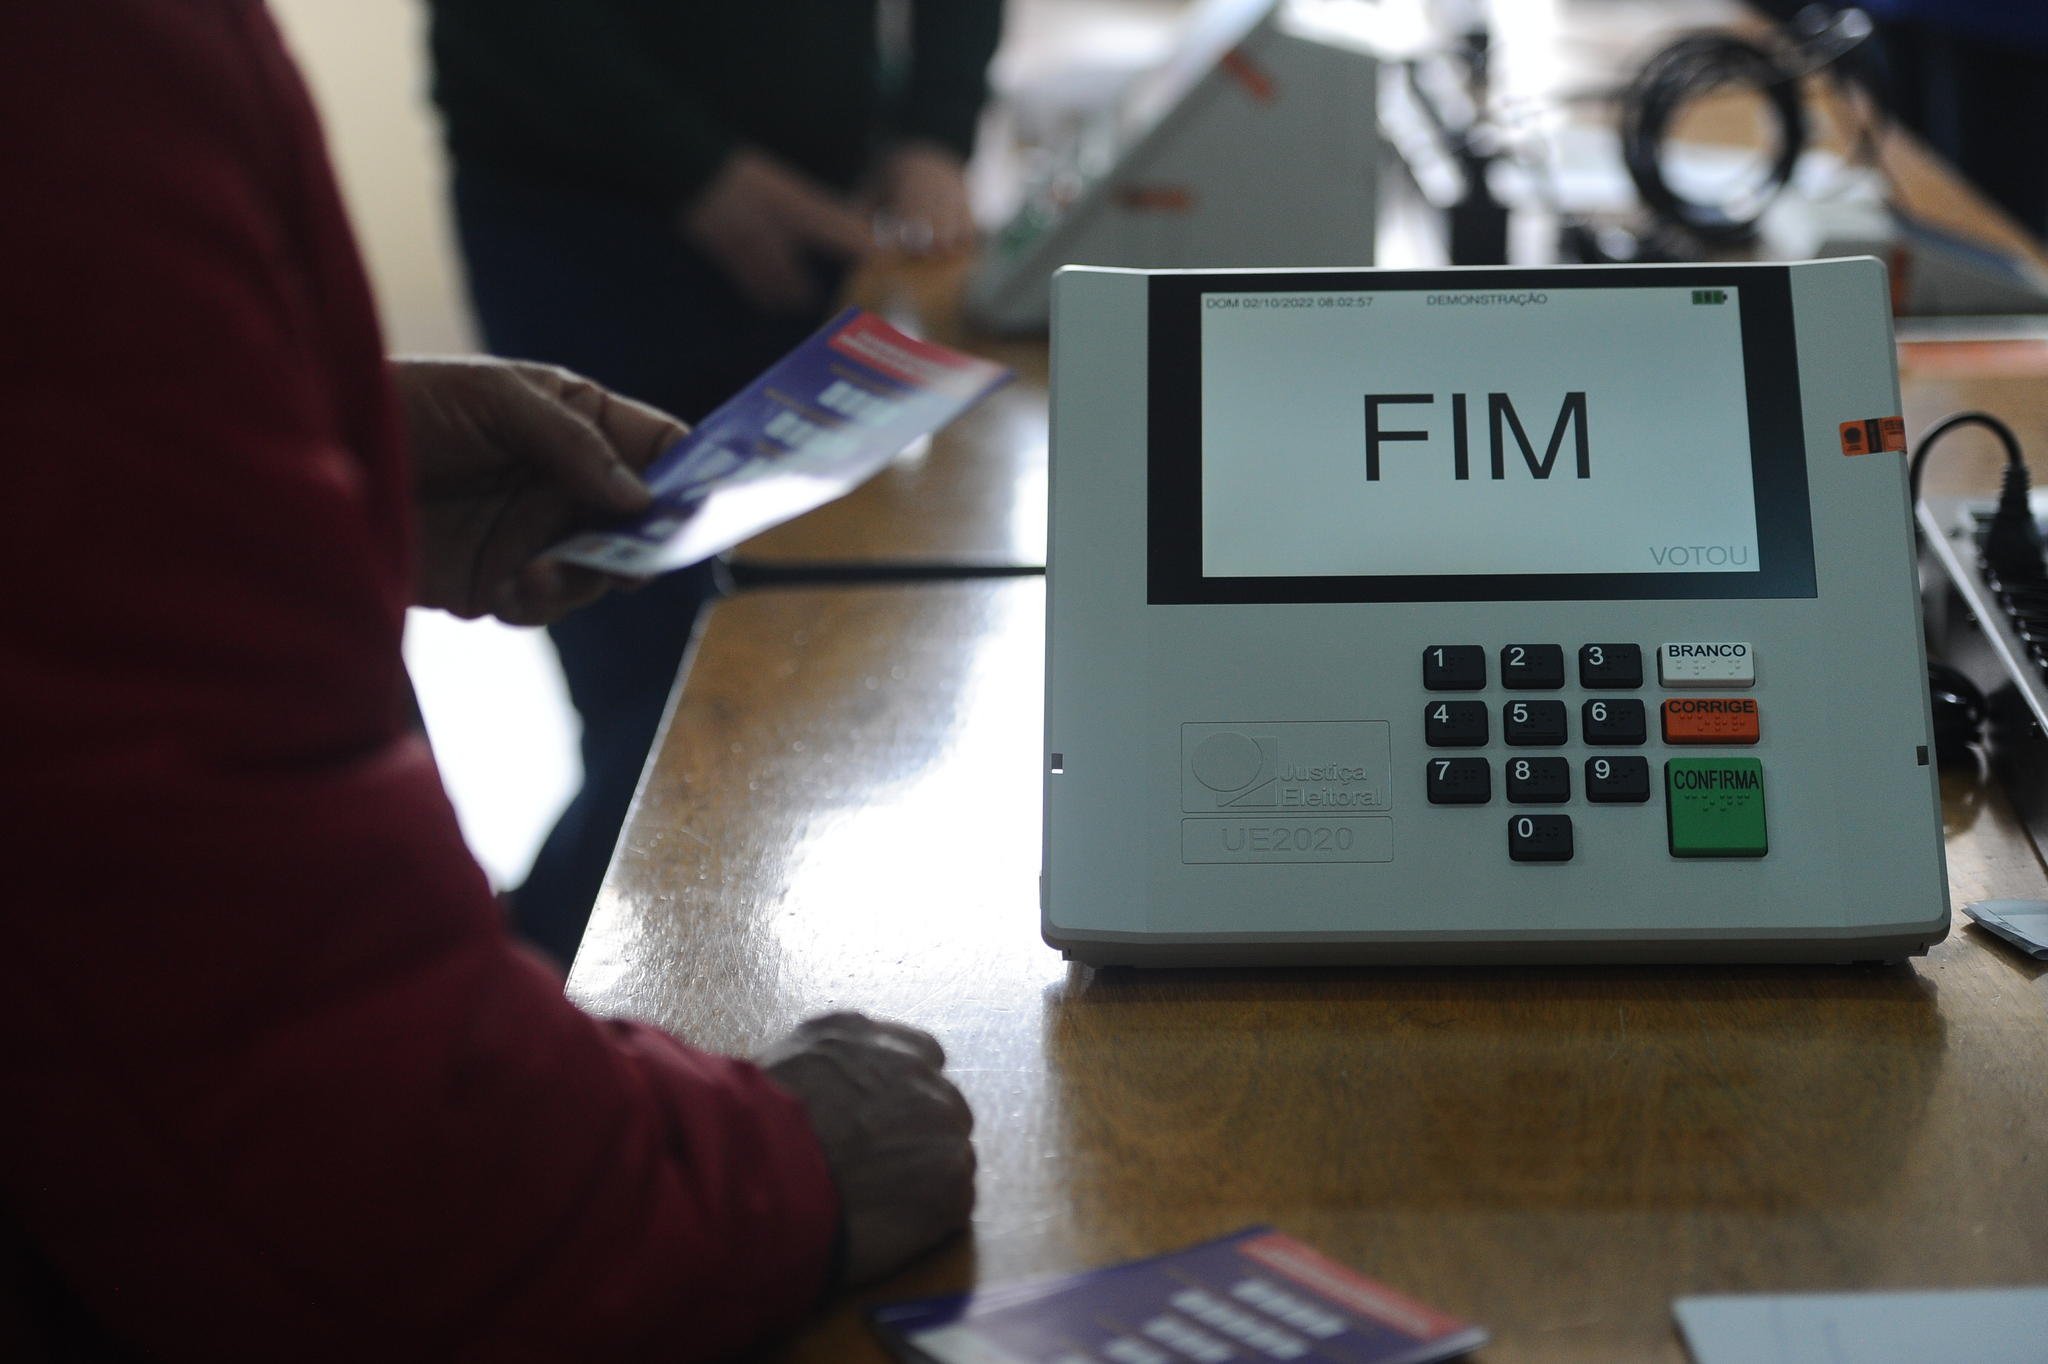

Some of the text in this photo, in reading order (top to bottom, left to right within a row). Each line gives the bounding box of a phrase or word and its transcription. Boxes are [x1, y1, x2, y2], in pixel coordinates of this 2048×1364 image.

[1206, 295, 1374, 309] DOM 02/10/2022 08:02:57
[1426, 292, 1548, 306] DEMONSTRAÇÃO
[1364, 391, 1591, 482] FIM
[1649, 545, 1748, 567] VOTOU
[1433, 649, 1444, 668] 1
[1510, 647, 1526, 666] 2
[1589, 646, 1604, 666] 3
[1668, 644, 1747, 658] BRANCO
[1433, 704, 1449, 723] 4
[1512, 703, 1528, 723] 5
[1591, 702, 1607, 721] 6
[1668, 700, 1755, 714] CORRIGE
[1280, 762, 1367, 785] Justiça
[1434, 761, 1450, 780] 7
[1515, 760, 1531, 780] 8
[1594, 760, 1610, 779] 9
[1673, 769, 1760, 790] CONFIRMA
[1281, 787, 1382, 808] Eleitoral
[1517, 818, 1534, 838] 0
[1221, 827, 1354, 851] UE2020
